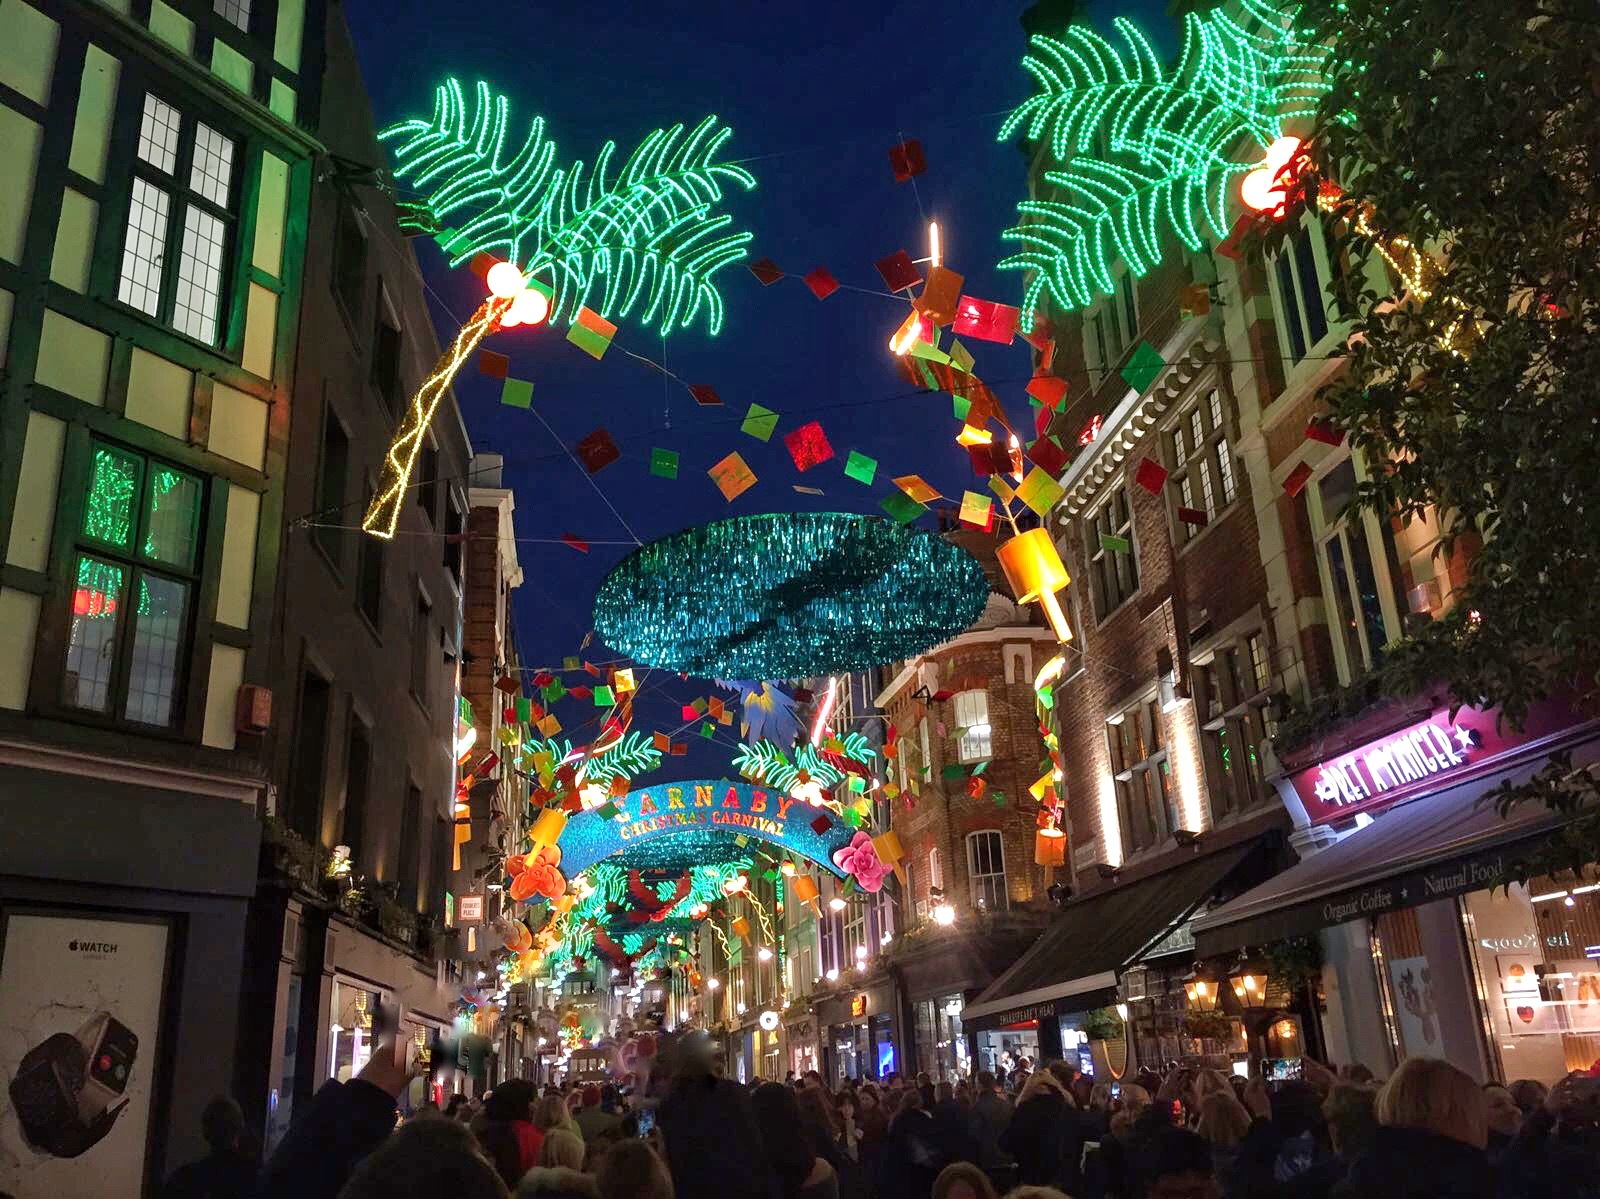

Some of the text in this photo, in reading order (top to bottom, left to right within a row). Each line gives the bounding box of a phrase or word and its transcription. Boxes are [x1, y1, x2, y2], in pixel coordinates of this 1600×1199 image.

[1325, 755, 1371, 807] PRET
[1379, 724, 1463, 787] MANGER
[620, 810, 784, 840] CHRISTMAS CARNIVAL
[1323, 858, 1503, 921] Organic Coffee Natural Food
[80, 941, 118, 953] WATCH
